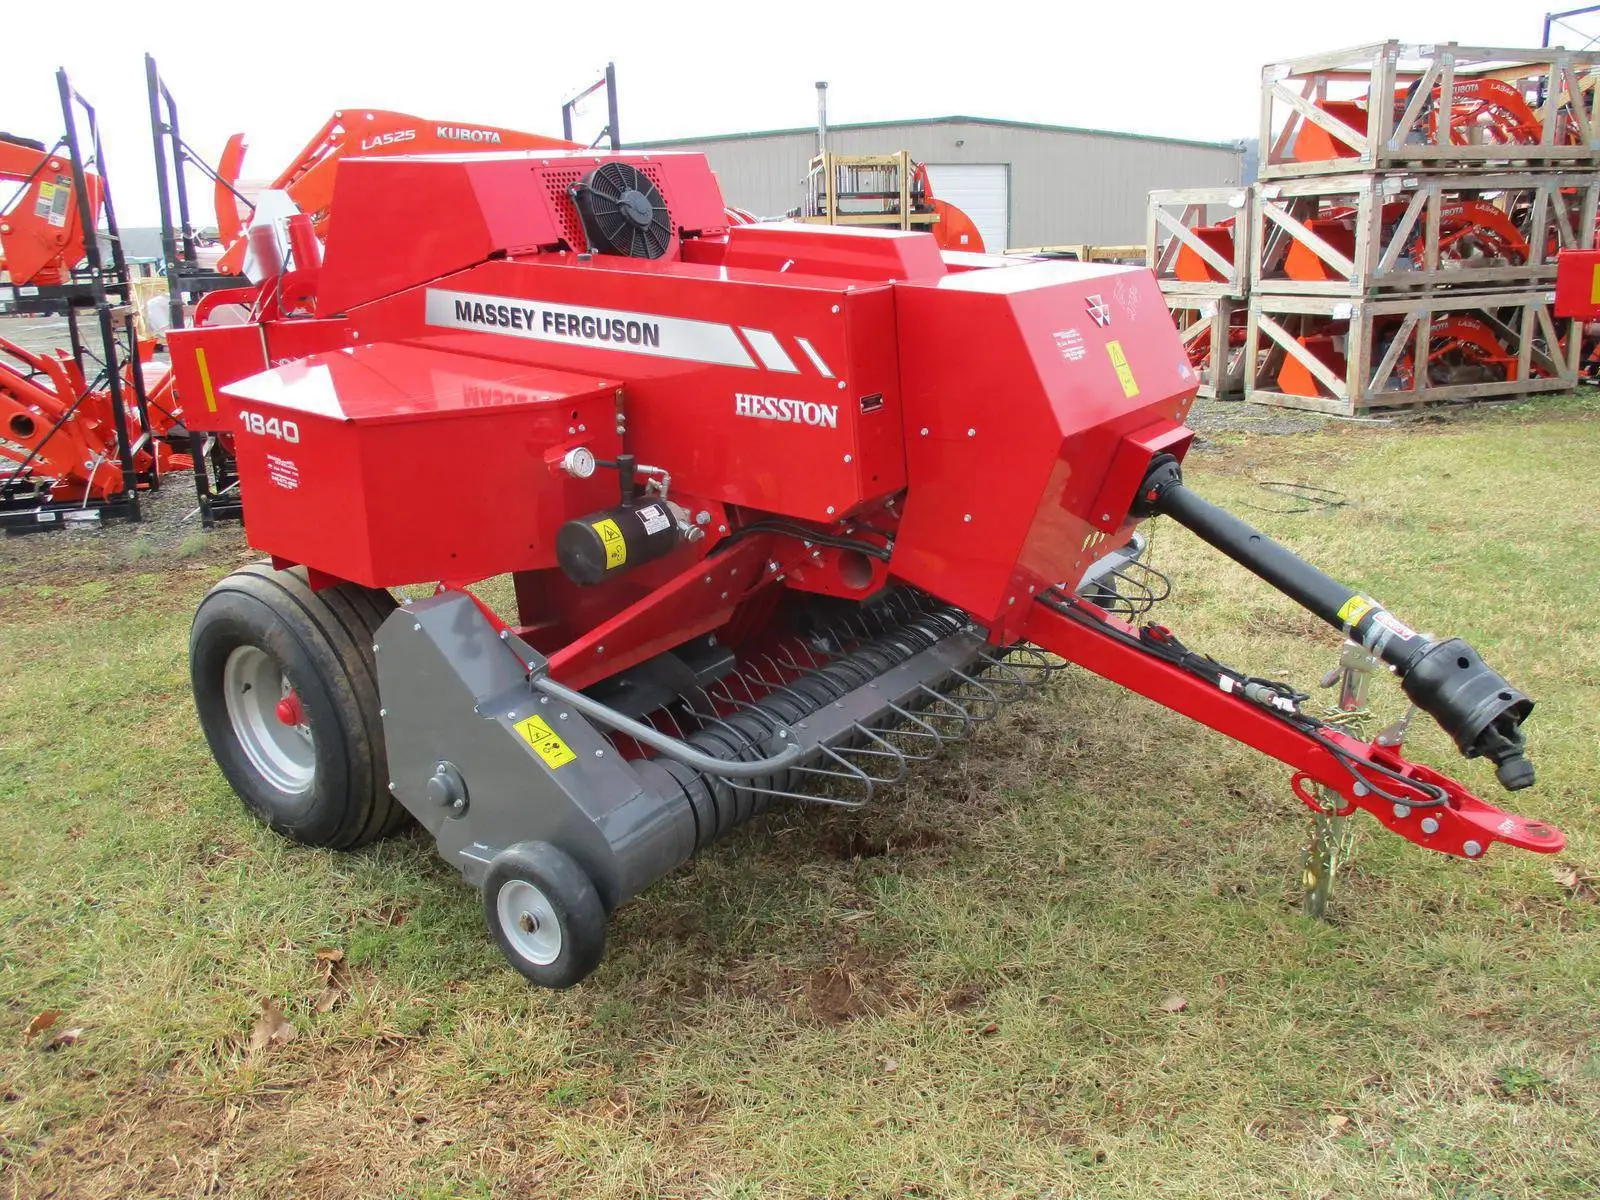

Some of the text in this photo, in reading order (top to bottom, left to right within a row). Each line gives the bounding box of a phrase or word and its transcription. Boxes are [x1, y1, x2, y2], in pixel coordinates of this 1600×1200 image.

[1453, 83, 1479, 93] UBOTA
[361, 129, 416, 150] LA525
[437, 126, 502, 144] KUBOTA
[455, 299, 661, 348] MASSEY FERGUSON
[735, 393, 838, 429] HESSTON
[239, 410, 300, 443] 1840
